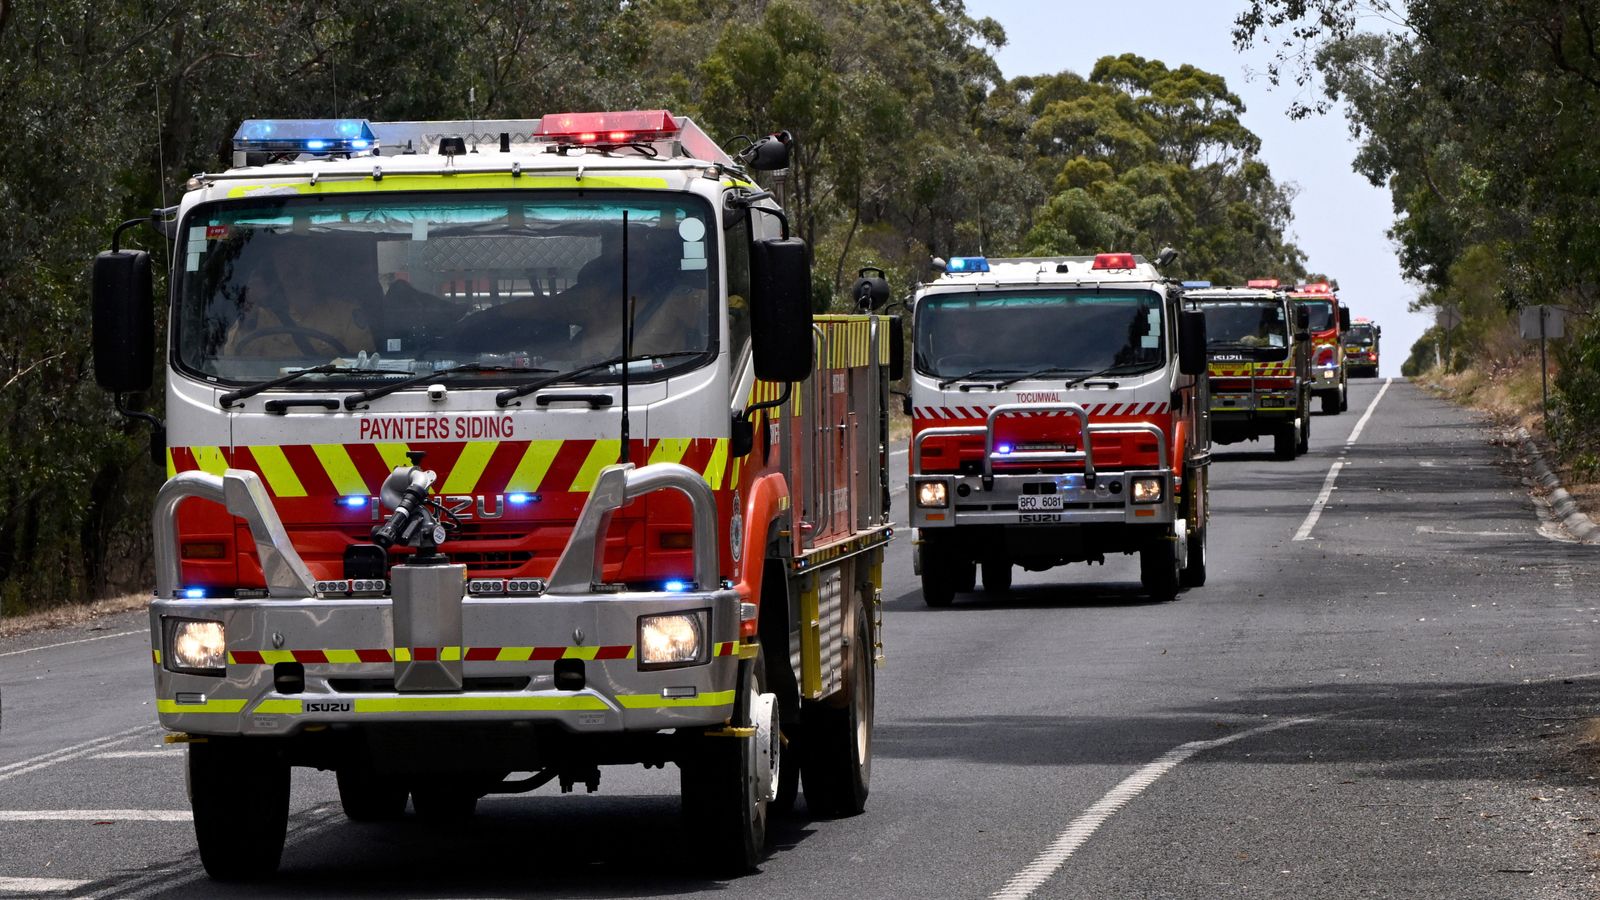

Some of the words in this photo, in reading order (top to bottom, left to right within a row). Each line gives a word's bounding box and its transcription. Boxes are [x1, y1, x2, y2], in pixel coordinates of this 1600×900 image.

[1016, 392, 1061, 403] TOCUMWAL
[360, 417, 449, 439] PAYNTERS
[455, 416, 514, 439] SIDING
[1020, 497, 1037, 507] BFO
[1042, 496, 1061, 507] 6081
[371, 494, 504, 521] IZU
[1018, 514, 1062, 523] ISUZU
[306, 703, 350, 712] ISUZU
